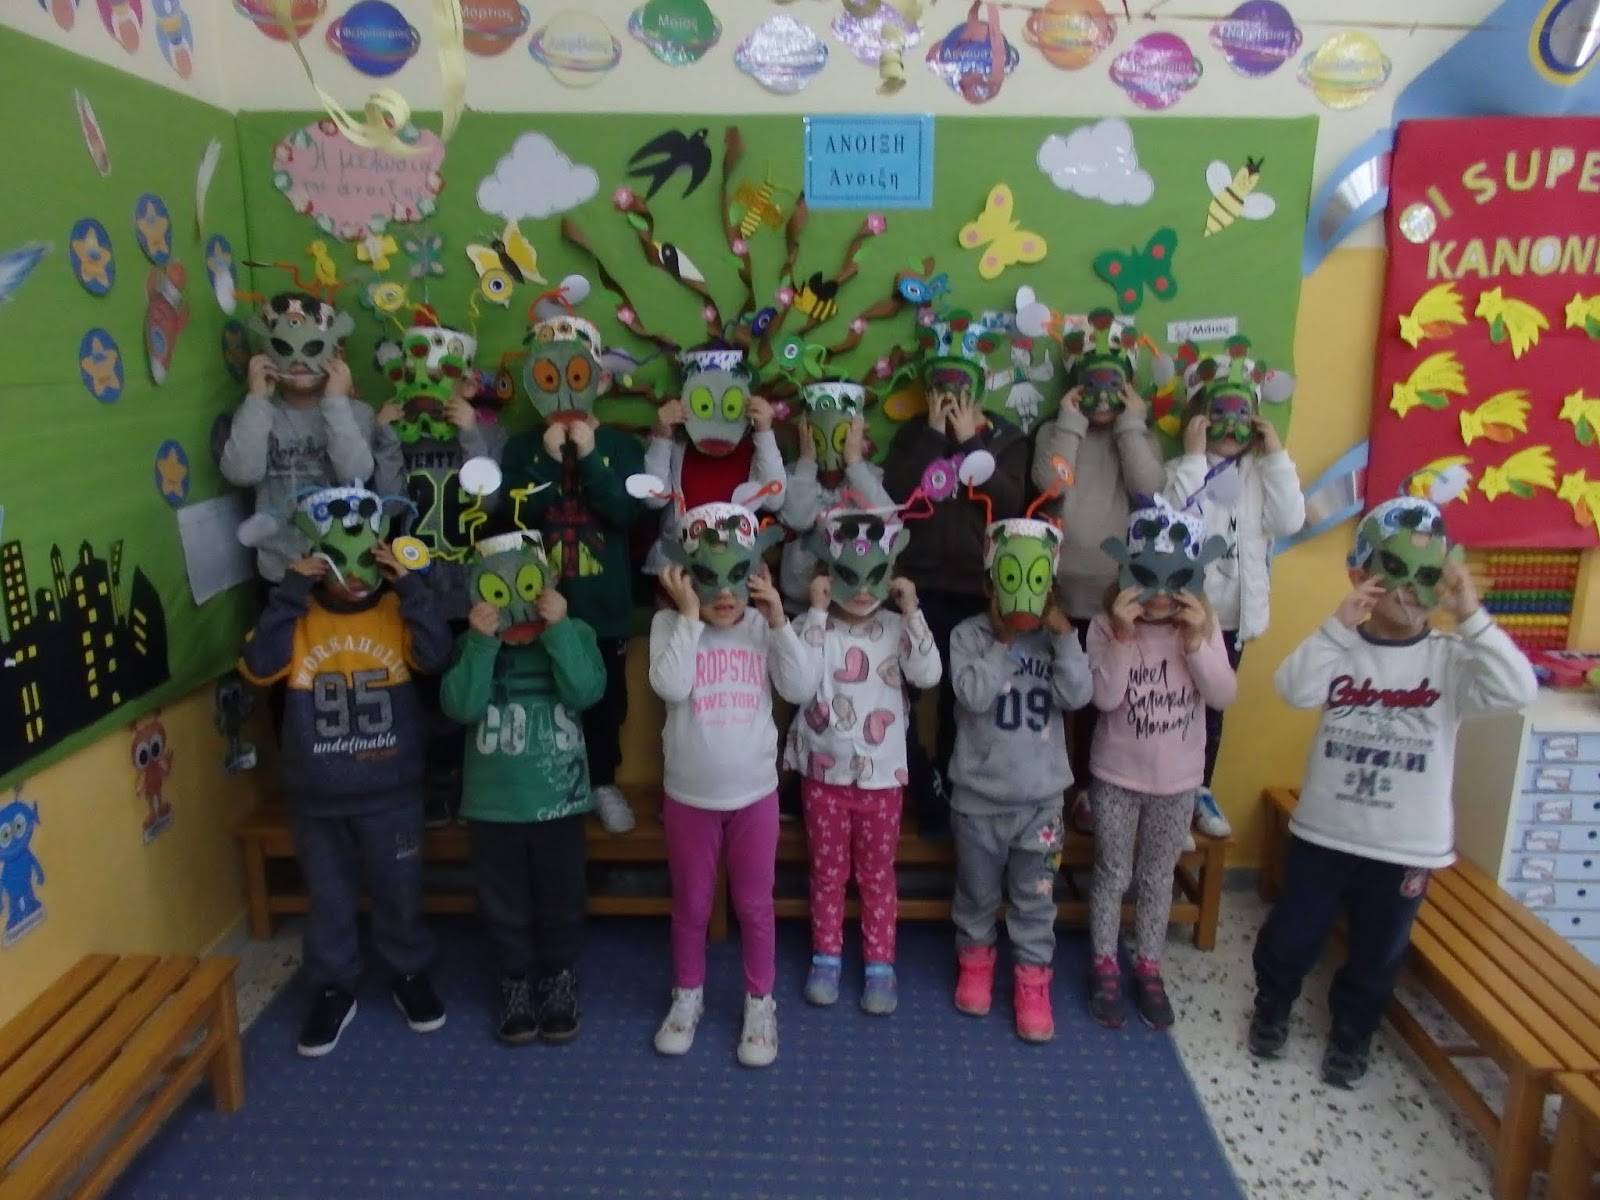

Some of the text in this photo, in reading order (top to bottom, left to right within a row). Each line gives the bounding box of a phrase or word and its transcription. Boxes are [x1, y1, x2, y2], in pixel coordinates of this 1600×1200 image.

[825, 133, 905, 154] ΑΝΟΙΞΗ
[313, 668, 393, 738] 95
[995, 687, 1053, 731] 09
[1325, 674, 1441, 710] Colorado
[313, 732, 397, 754] undefinable
